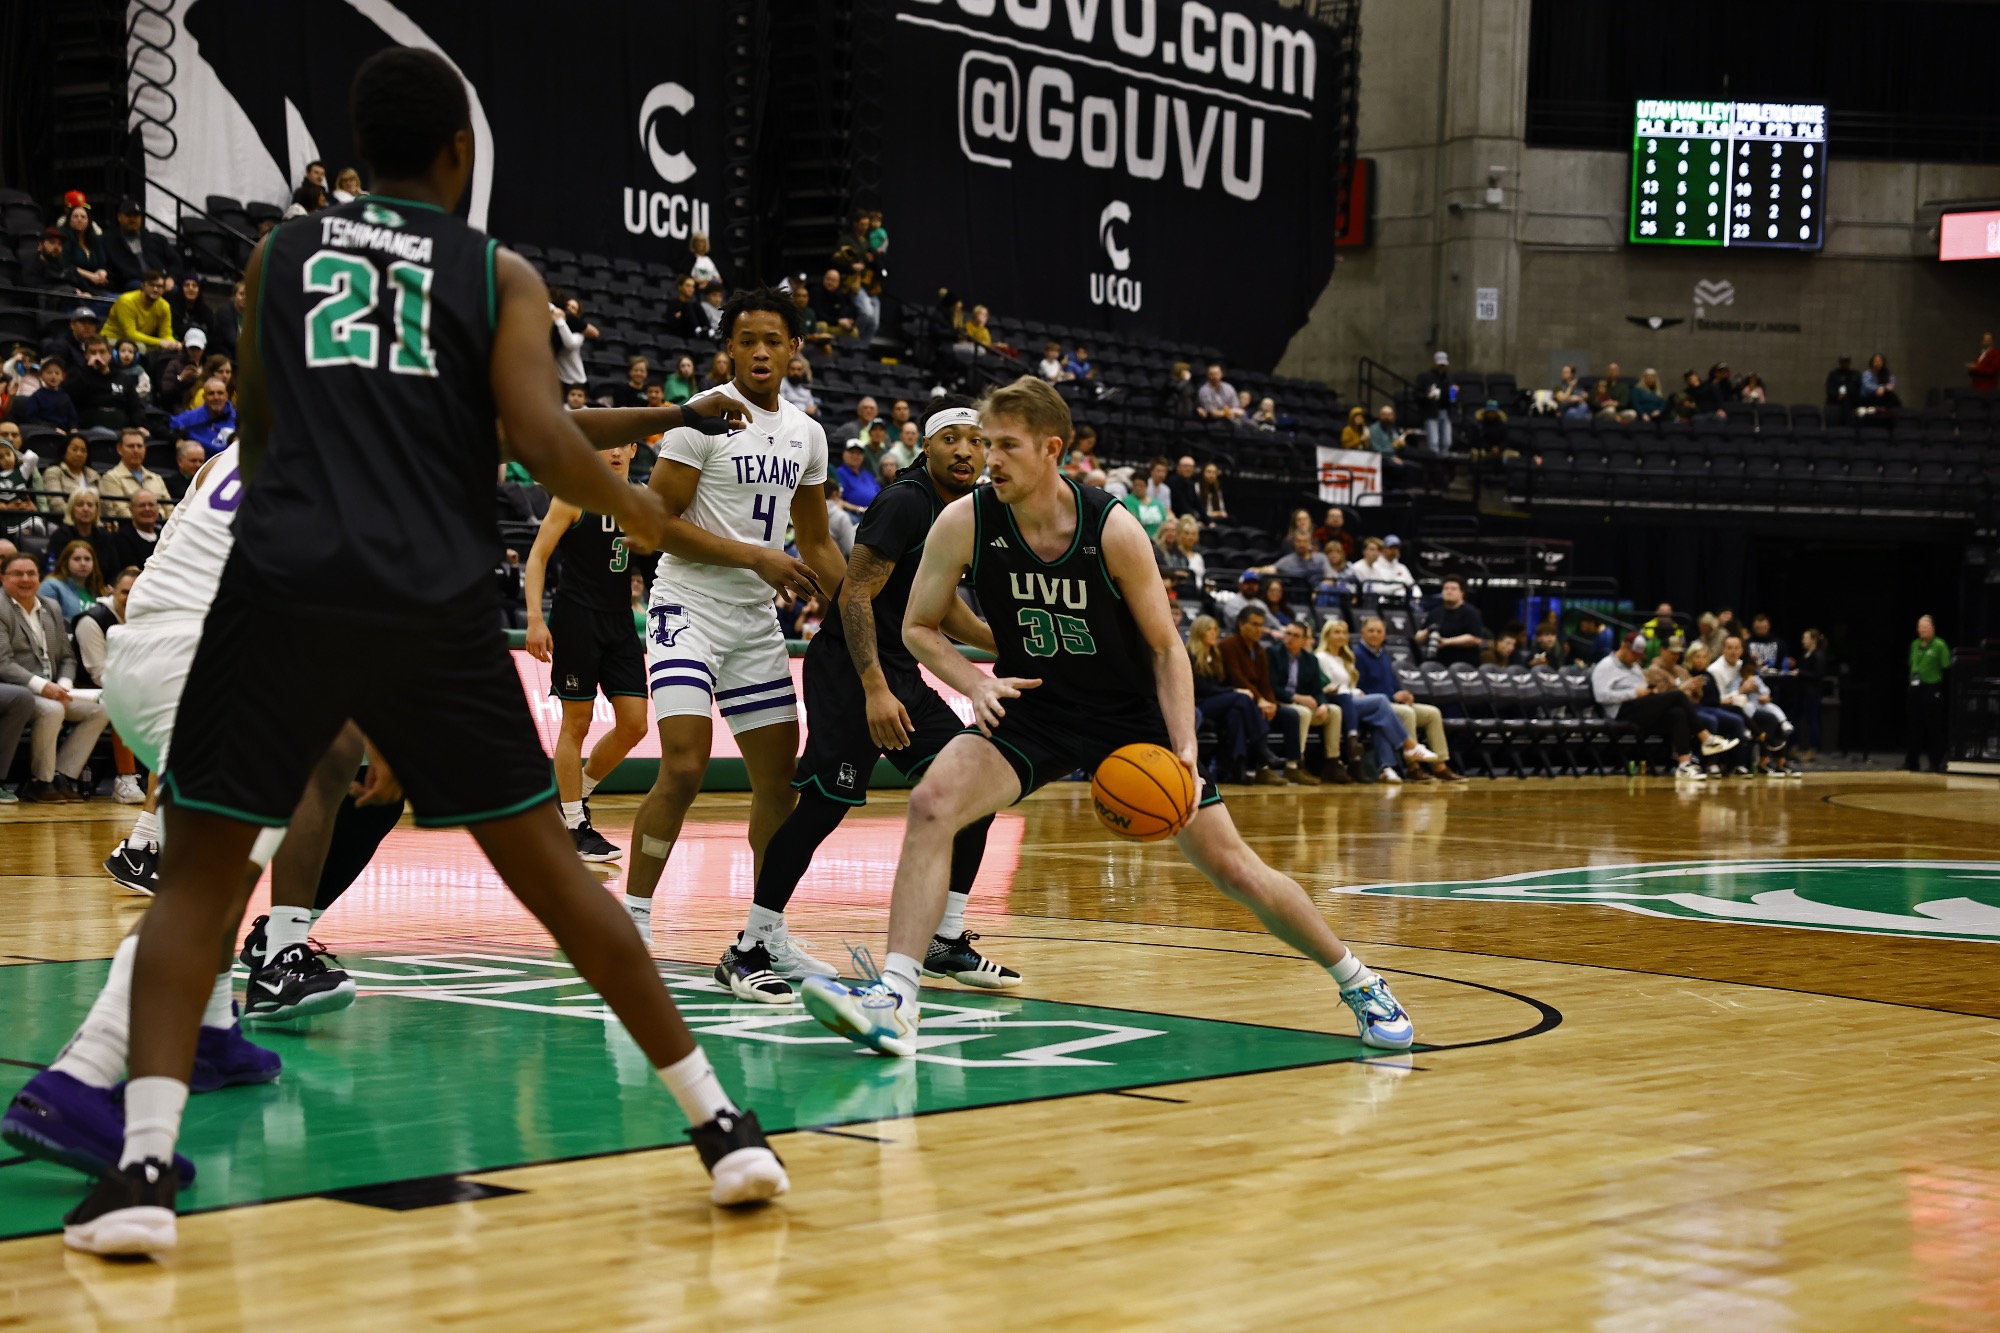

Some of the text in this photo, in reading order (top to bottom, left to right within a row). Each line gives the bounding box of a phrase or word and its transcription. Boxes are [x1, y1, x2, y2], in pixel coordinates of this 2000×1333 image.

[906, 0, 1317, 100] U.com
[1637, 100, 1730, 121] UTAH VALLEY
[1792, 105, 1825, 124] STATE
[958, 49, 1266, 201] @GoUVU
[1671, 119, 1697, 134] PTS
[1766, 123, 1792, 137] PTS
[1647, 139, 1721, 156] 3 4 0
[1739, 141, 1814, 159] 4 3 0
[1677, 160, 1688, 175] 0
[1709, 161, 1720, 176] 0
[1771, 163, 1781, 179] 2
[1803, 163, 1813, 179] 0
[1641, 179, 1659, 195] 13
[1709, 181, 1719, 197] 0
[1734, 182, 1812, 200] 10 2 0
[623, 186, 710, 240] UCCU
[1641, 199, 1718, 217] 21 0 0
[1734, 202, 1811, 220] 13 2 0
[1640, 220, 1716, 238] 35 2 1
[1733, 223, 1810, 240] 23 0 0
[320, 215, 434, 263] TSHIMANGA
[1090, 273, 1142, 312] UCCU
[302, 249, 440, 377] 21
[731, 455, 800, 490] TEXANS
[752, 493, 777, 541] 4
[1009, 572, 1087, 610] UVU
[1017, 607, 1097, 657] 35
